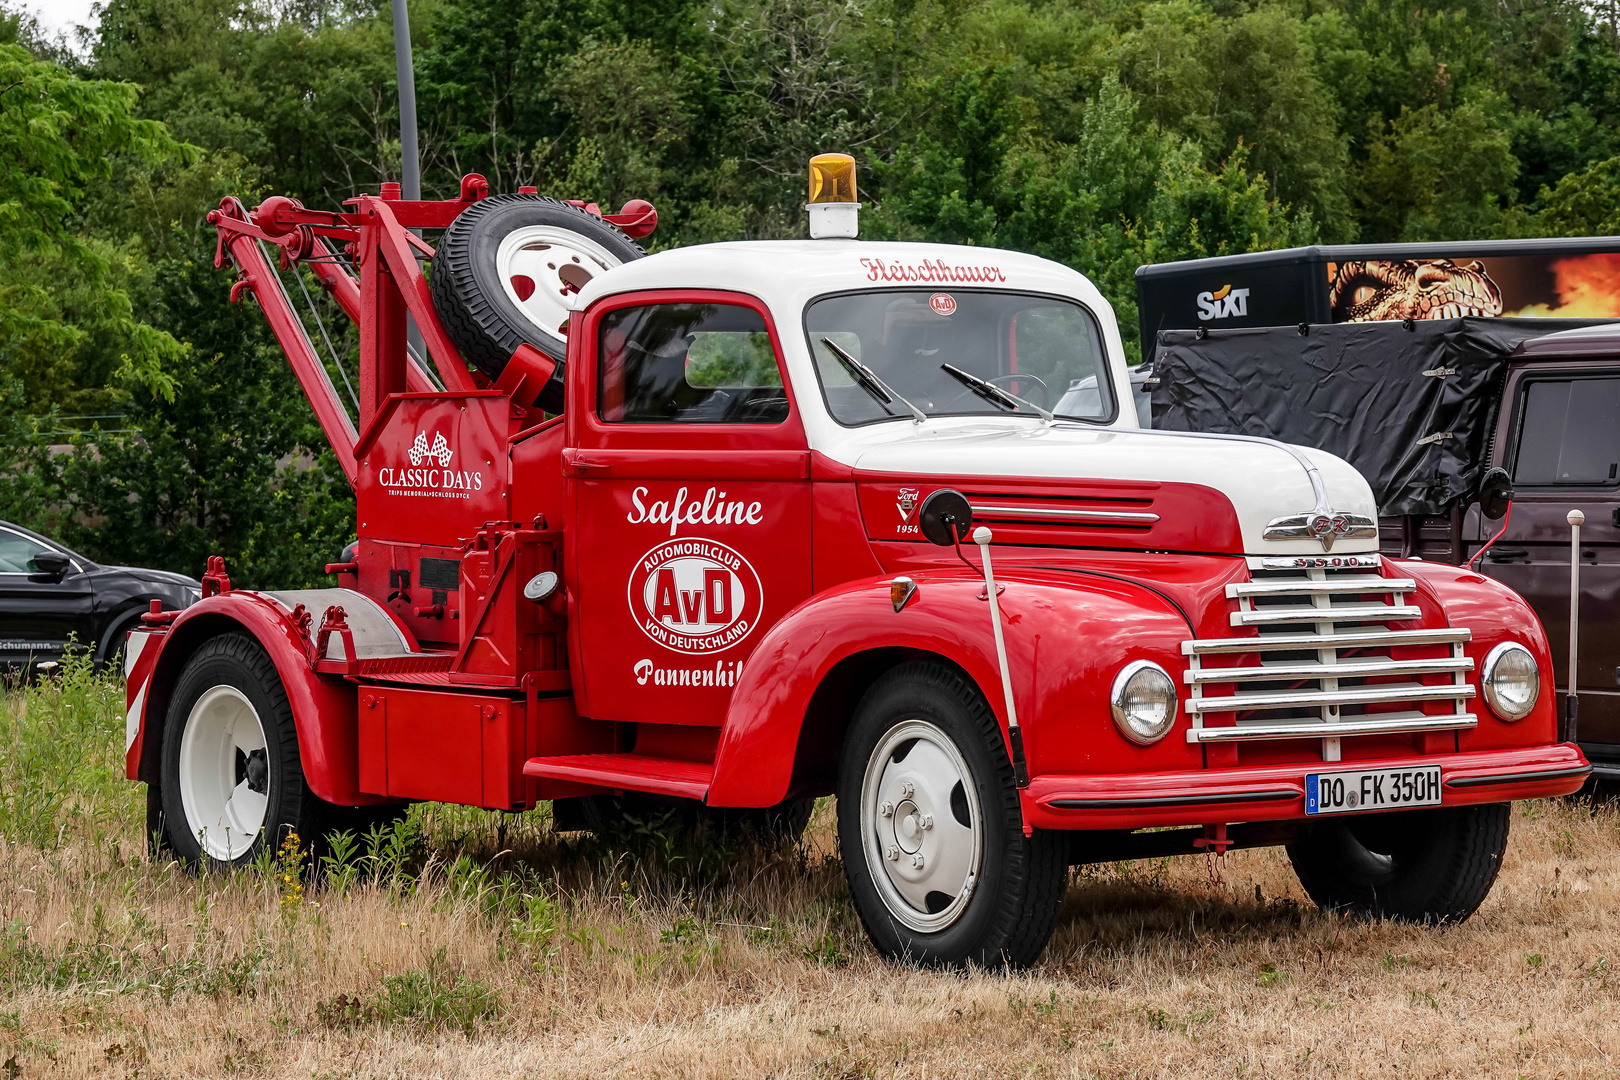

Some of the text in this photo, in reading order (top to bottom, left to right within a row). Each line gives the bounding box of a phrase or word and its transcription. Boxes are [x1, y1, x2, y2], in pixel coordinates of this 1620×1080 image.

[860, 258, 1006, 283] Fleischhauer
[379, 467, 482, 491] CLASSIC DAYS
[897, 487, 920, 500] Ford
[627, 486, 764, 536] Safeline
[896, 525, 919, 534] 1954
[644, 543, 741, 573] AUTOMOBILCLUB
[1297, 557, 1358, 568] 3500
[653, 567, 733, 625] AvD
[645, 618, 749, 650] VON DEUTSCHLAND
[1310, 771, 1440, 808] D DO FK 350H
